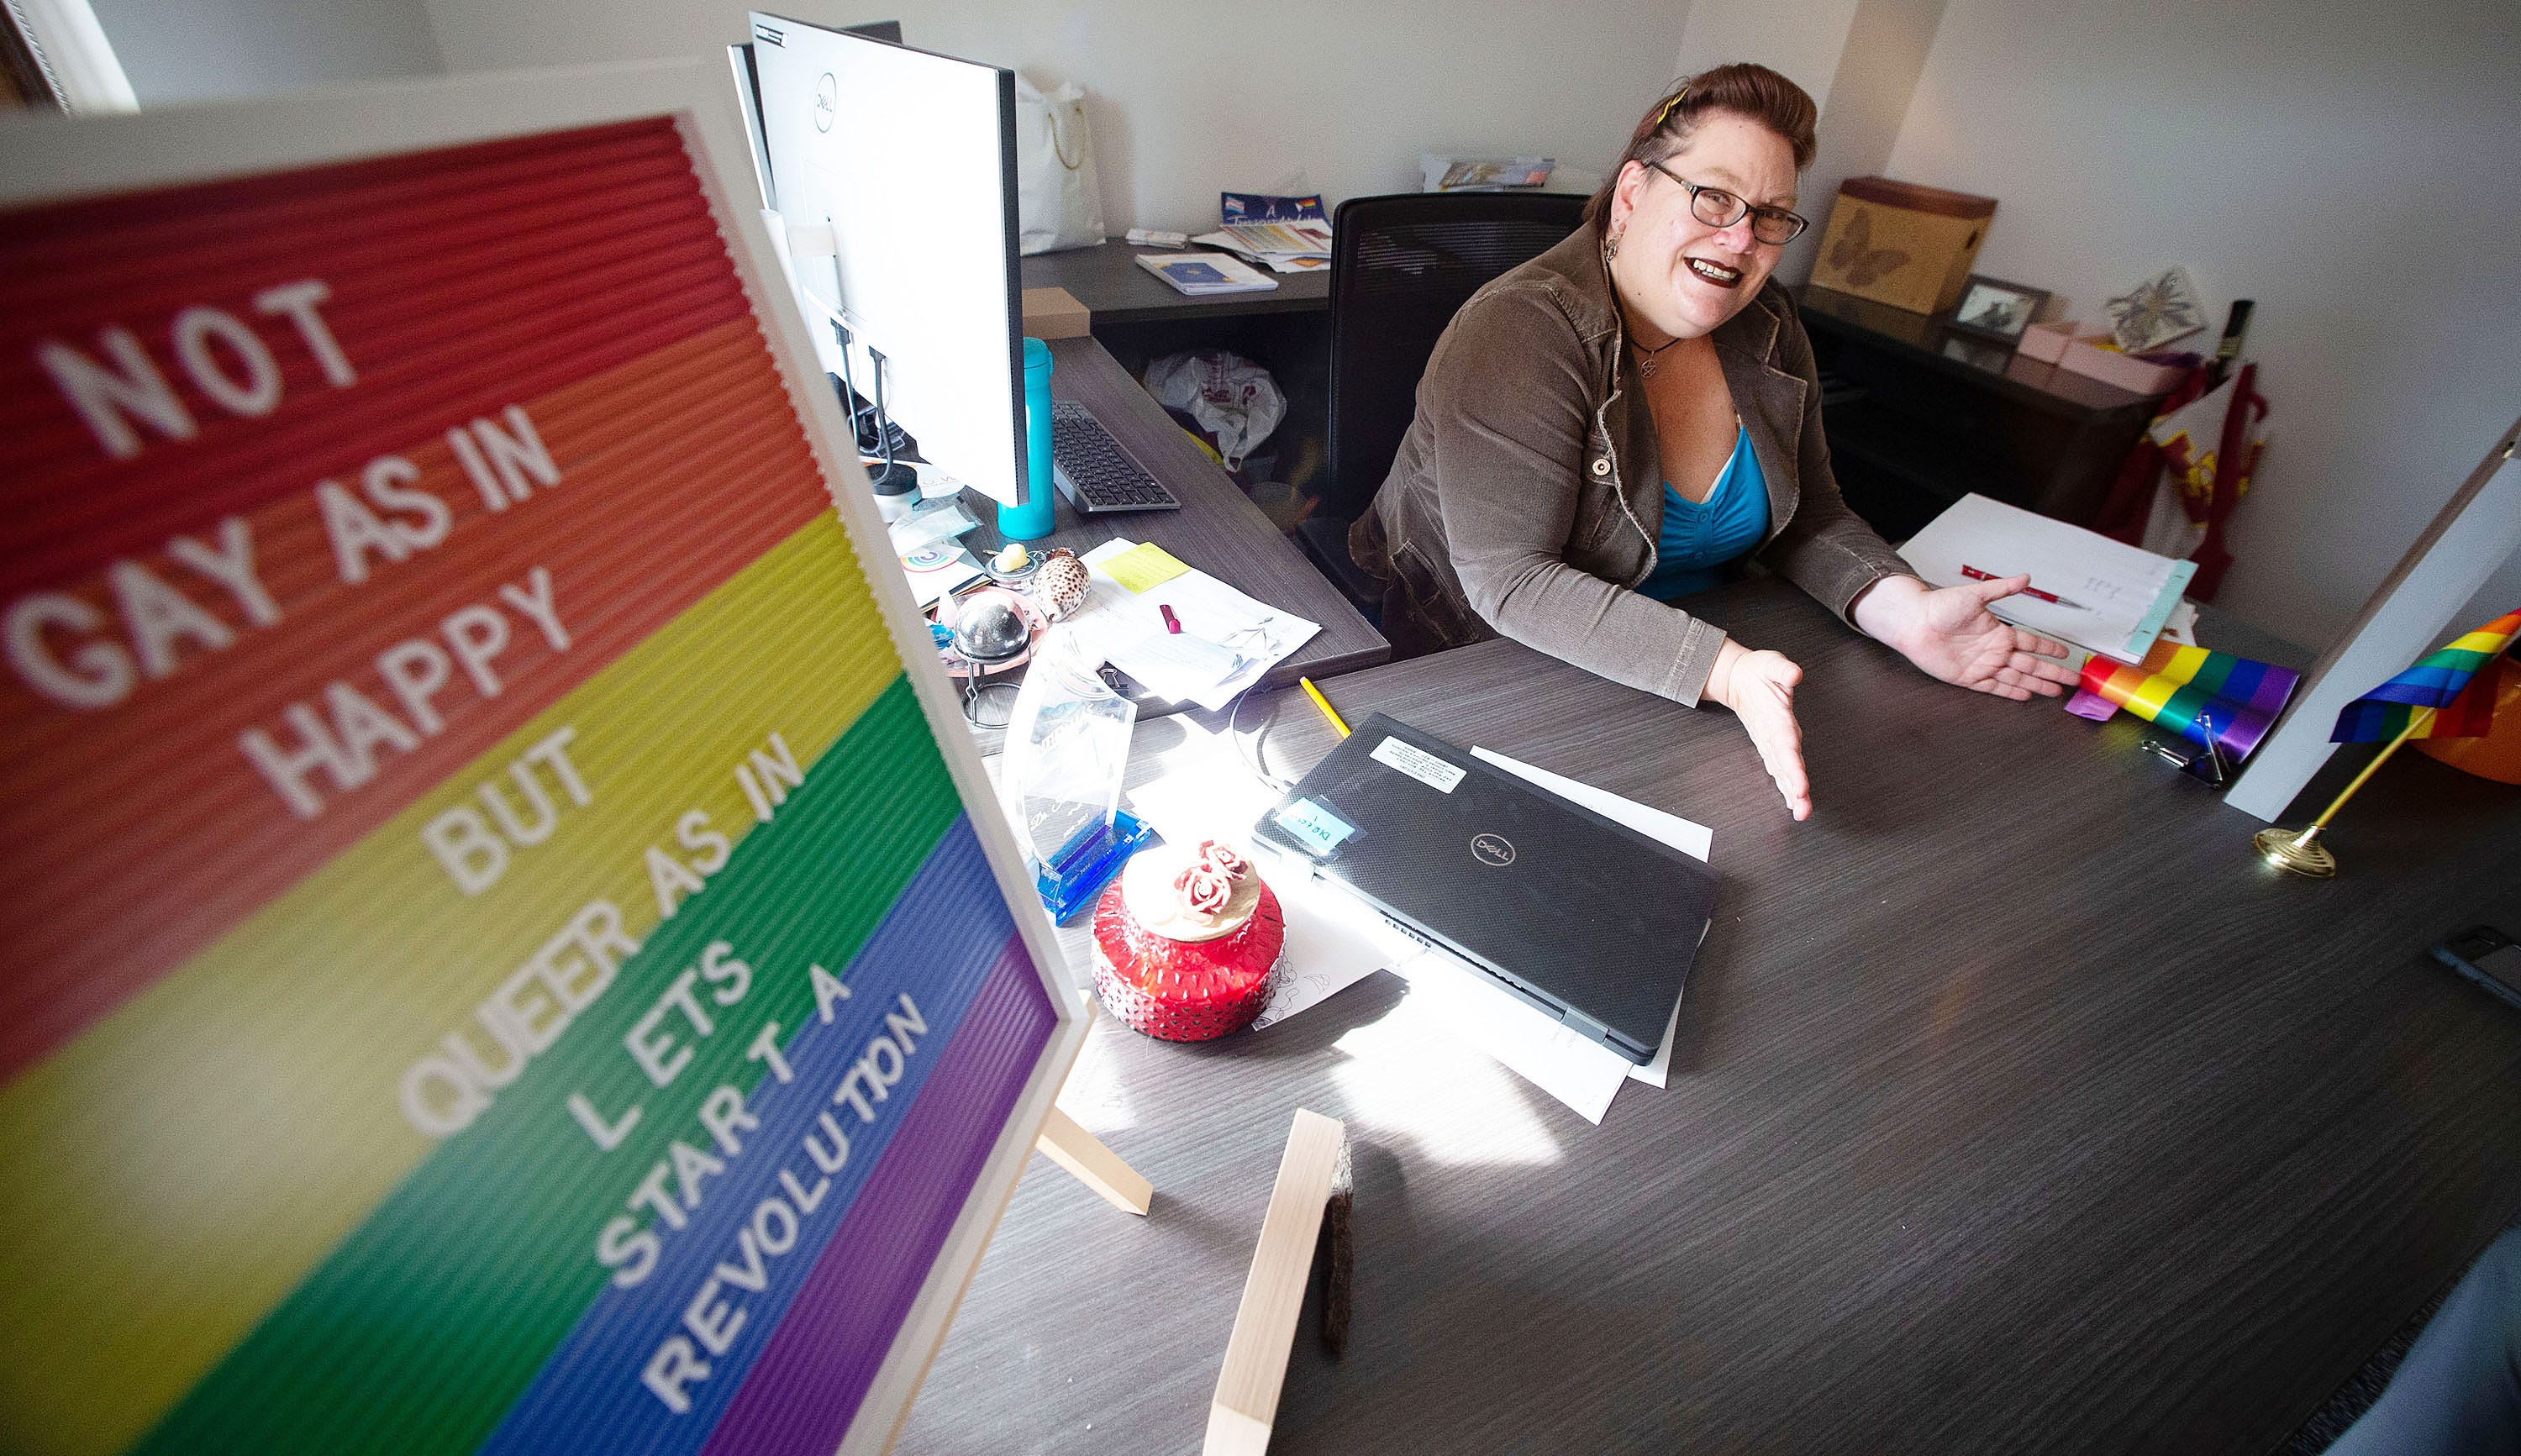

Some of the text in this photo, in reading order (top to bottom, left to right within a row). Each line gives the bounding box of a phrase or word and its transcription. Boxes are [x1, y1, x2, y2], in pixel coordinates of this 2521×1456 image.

[38, 280, 357, 458] NOT
[3, 404, 561, 708] GAY AS IN
[239, 566, 571, 818] HAPPY
[420, 726, 592, 897] BUT
[399, 732, 805, 1136] QUEER AS IN
[1476, 839, 1508, 861] DELL
[569, 939, 753, 1151] LETS
[597, 965, 852, 1288] START A
[641, 991, 930, 1414] REVOLUTION
